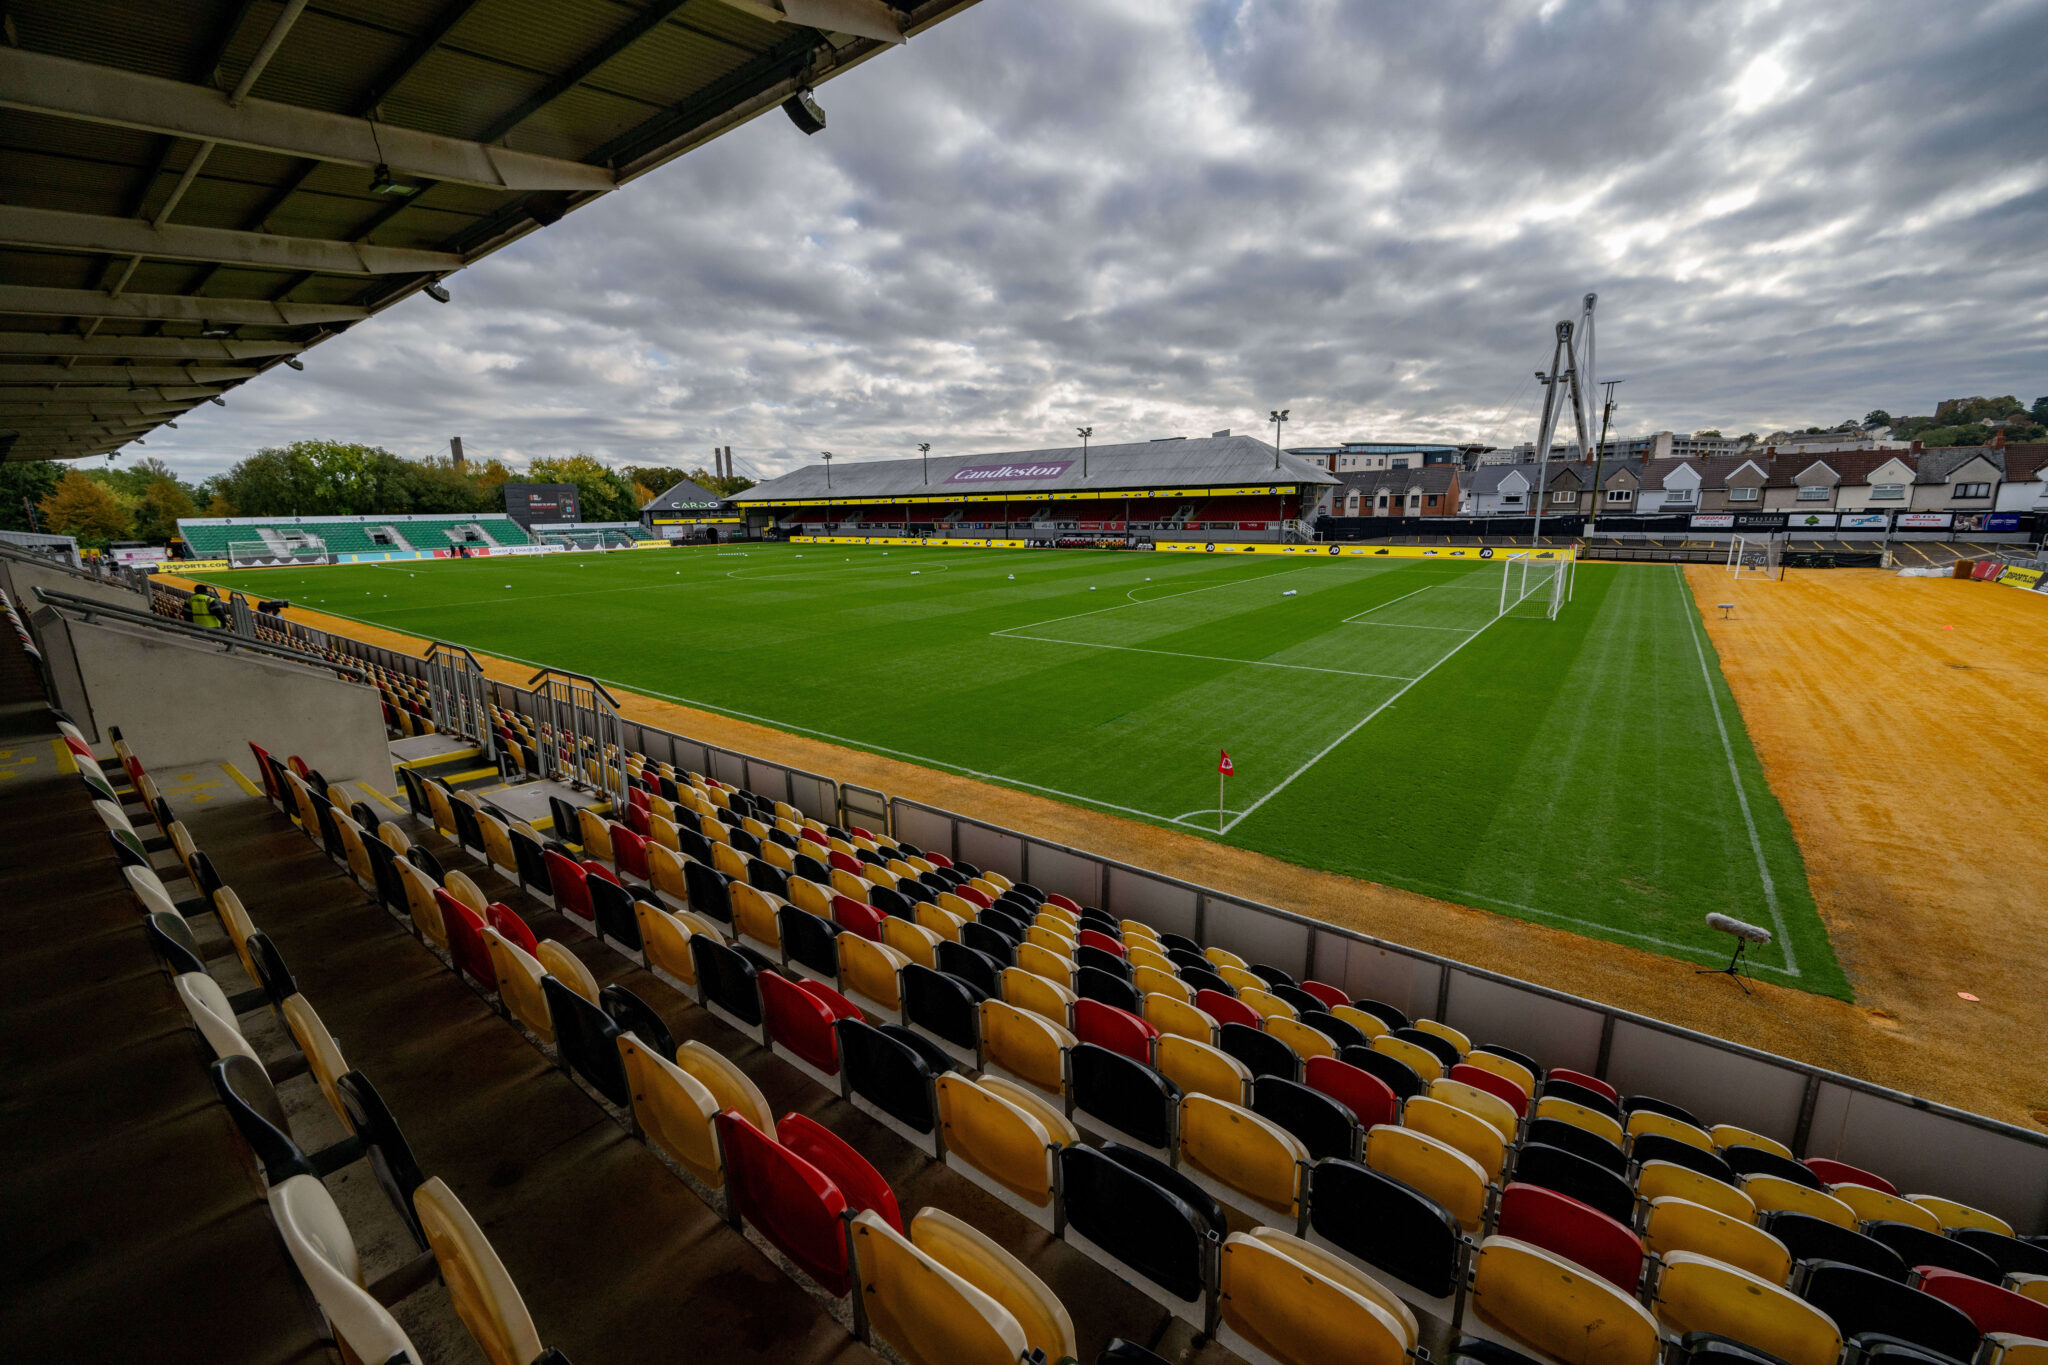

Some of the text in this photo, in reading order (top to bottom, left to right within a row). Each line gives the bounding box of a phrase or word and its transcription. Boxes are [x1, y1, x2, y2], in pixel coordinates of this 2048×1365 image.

[954, 466, 1061, 479] Candleston
[672, 501, 718, 509] CARDO
[162, 562, 228, 570] JDSPORTS.COM
